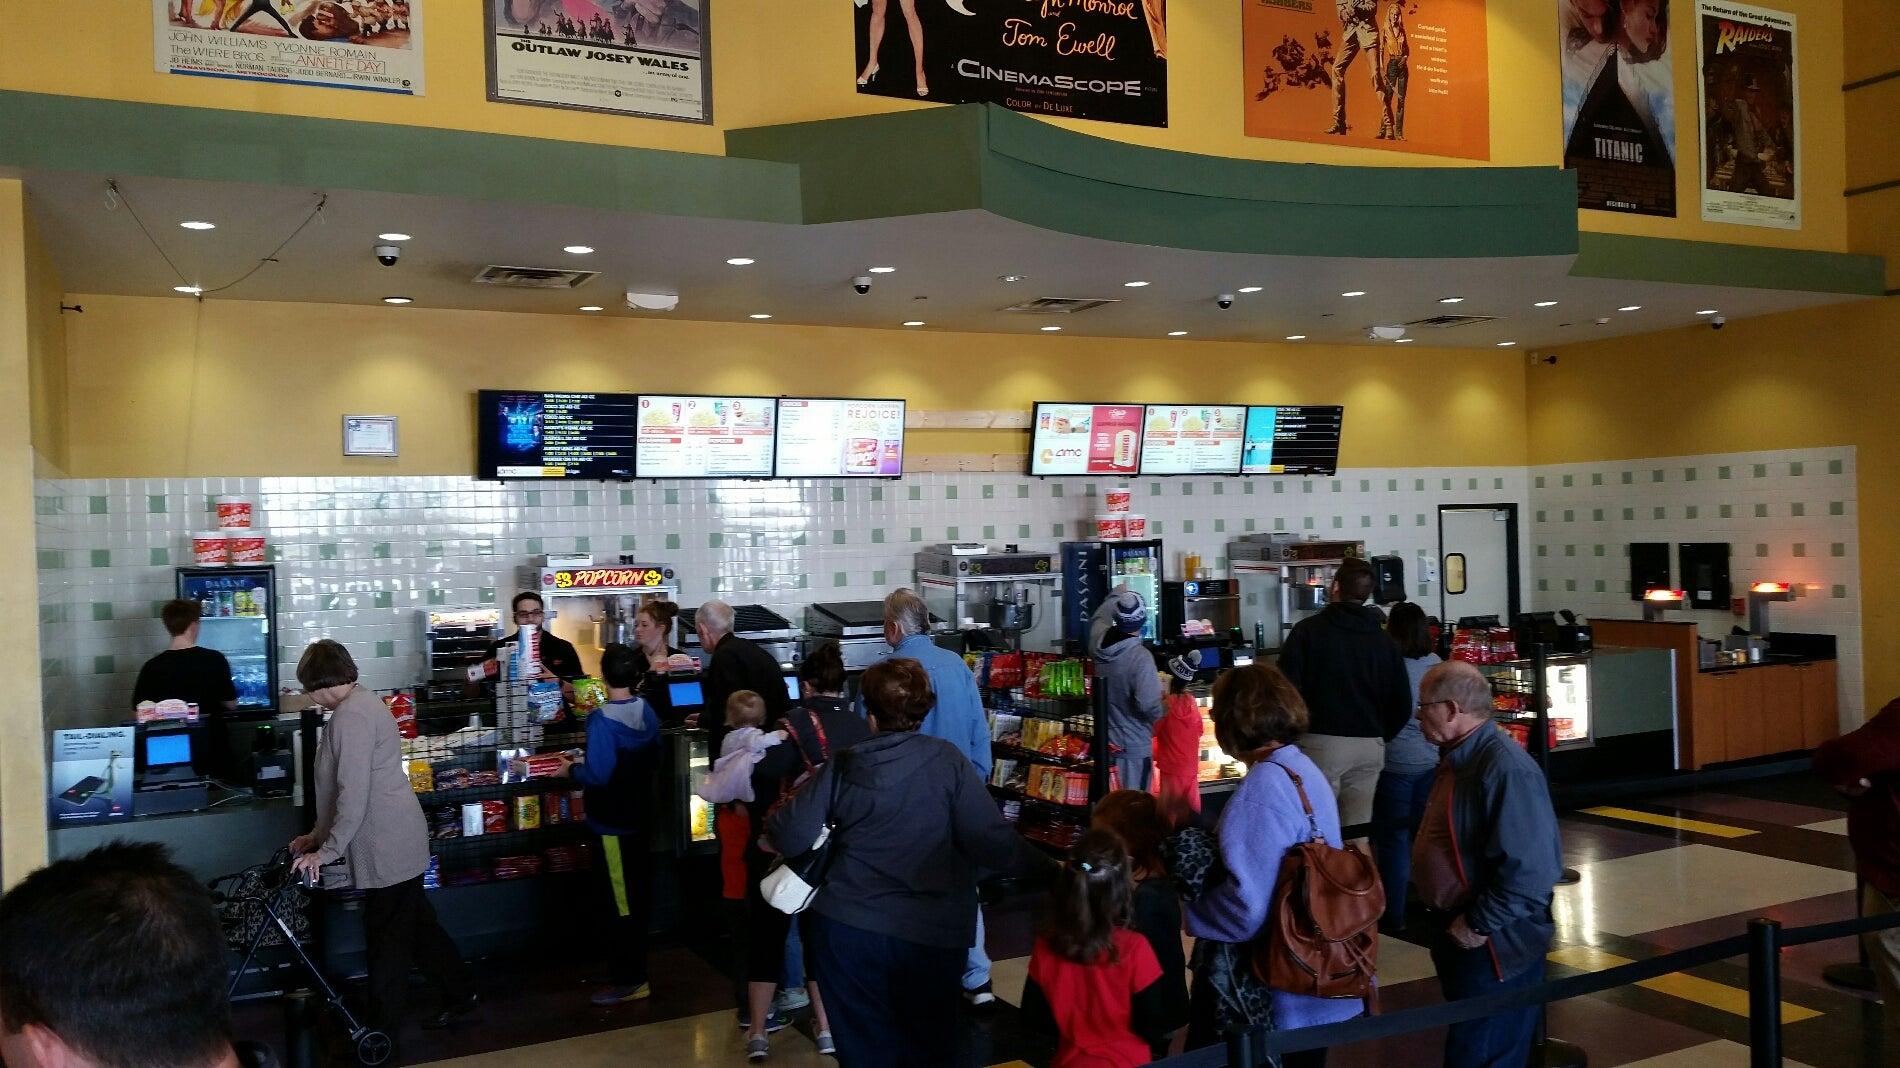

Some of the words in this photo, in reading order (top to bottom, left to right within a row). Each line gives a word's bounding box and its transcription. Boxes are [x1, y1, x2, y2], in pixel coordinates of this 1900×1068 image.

[1713, 6, 1731, 15] Return
[1739, 10, 1747, 18] the
[168, 31, 203, 44] JOHN
[208, 34, 268, 50] WILLIAMS
[274, 41, 325, 55] YVONNE
[329, 46, 377, 60] ROMAIN
[1002, 18, 1048, 47] Tom
[1056, 22, 1115, 61] Ewell
[1715, 20, 1773, 55] RAIDERS
[171, 44, 191, 55] The
[192, 46, 231, 59] WIERE
[232, 50, 266, 62] BROS.
[511, 41, 581, 58] OUTLAW
[585, 50, 635, 64] JOSEY
[636, 56, 689, 72] WALES
[176, 64, 225, 73] PANAVISION
[236, 69, 289, 78] METROCOLOR
[296, 54, 353, 71] ANNETTE
[357, 60, 382, 73] DAY
[1006, 97, 1032, 108] COLOR
[1594, 137, 1643, 163] TITANIC
[847, 409, 900, 420] REJOICE!
[573, 569, 645, 587] POPCORN
[1078, 551, 1089, 622] DASANI
